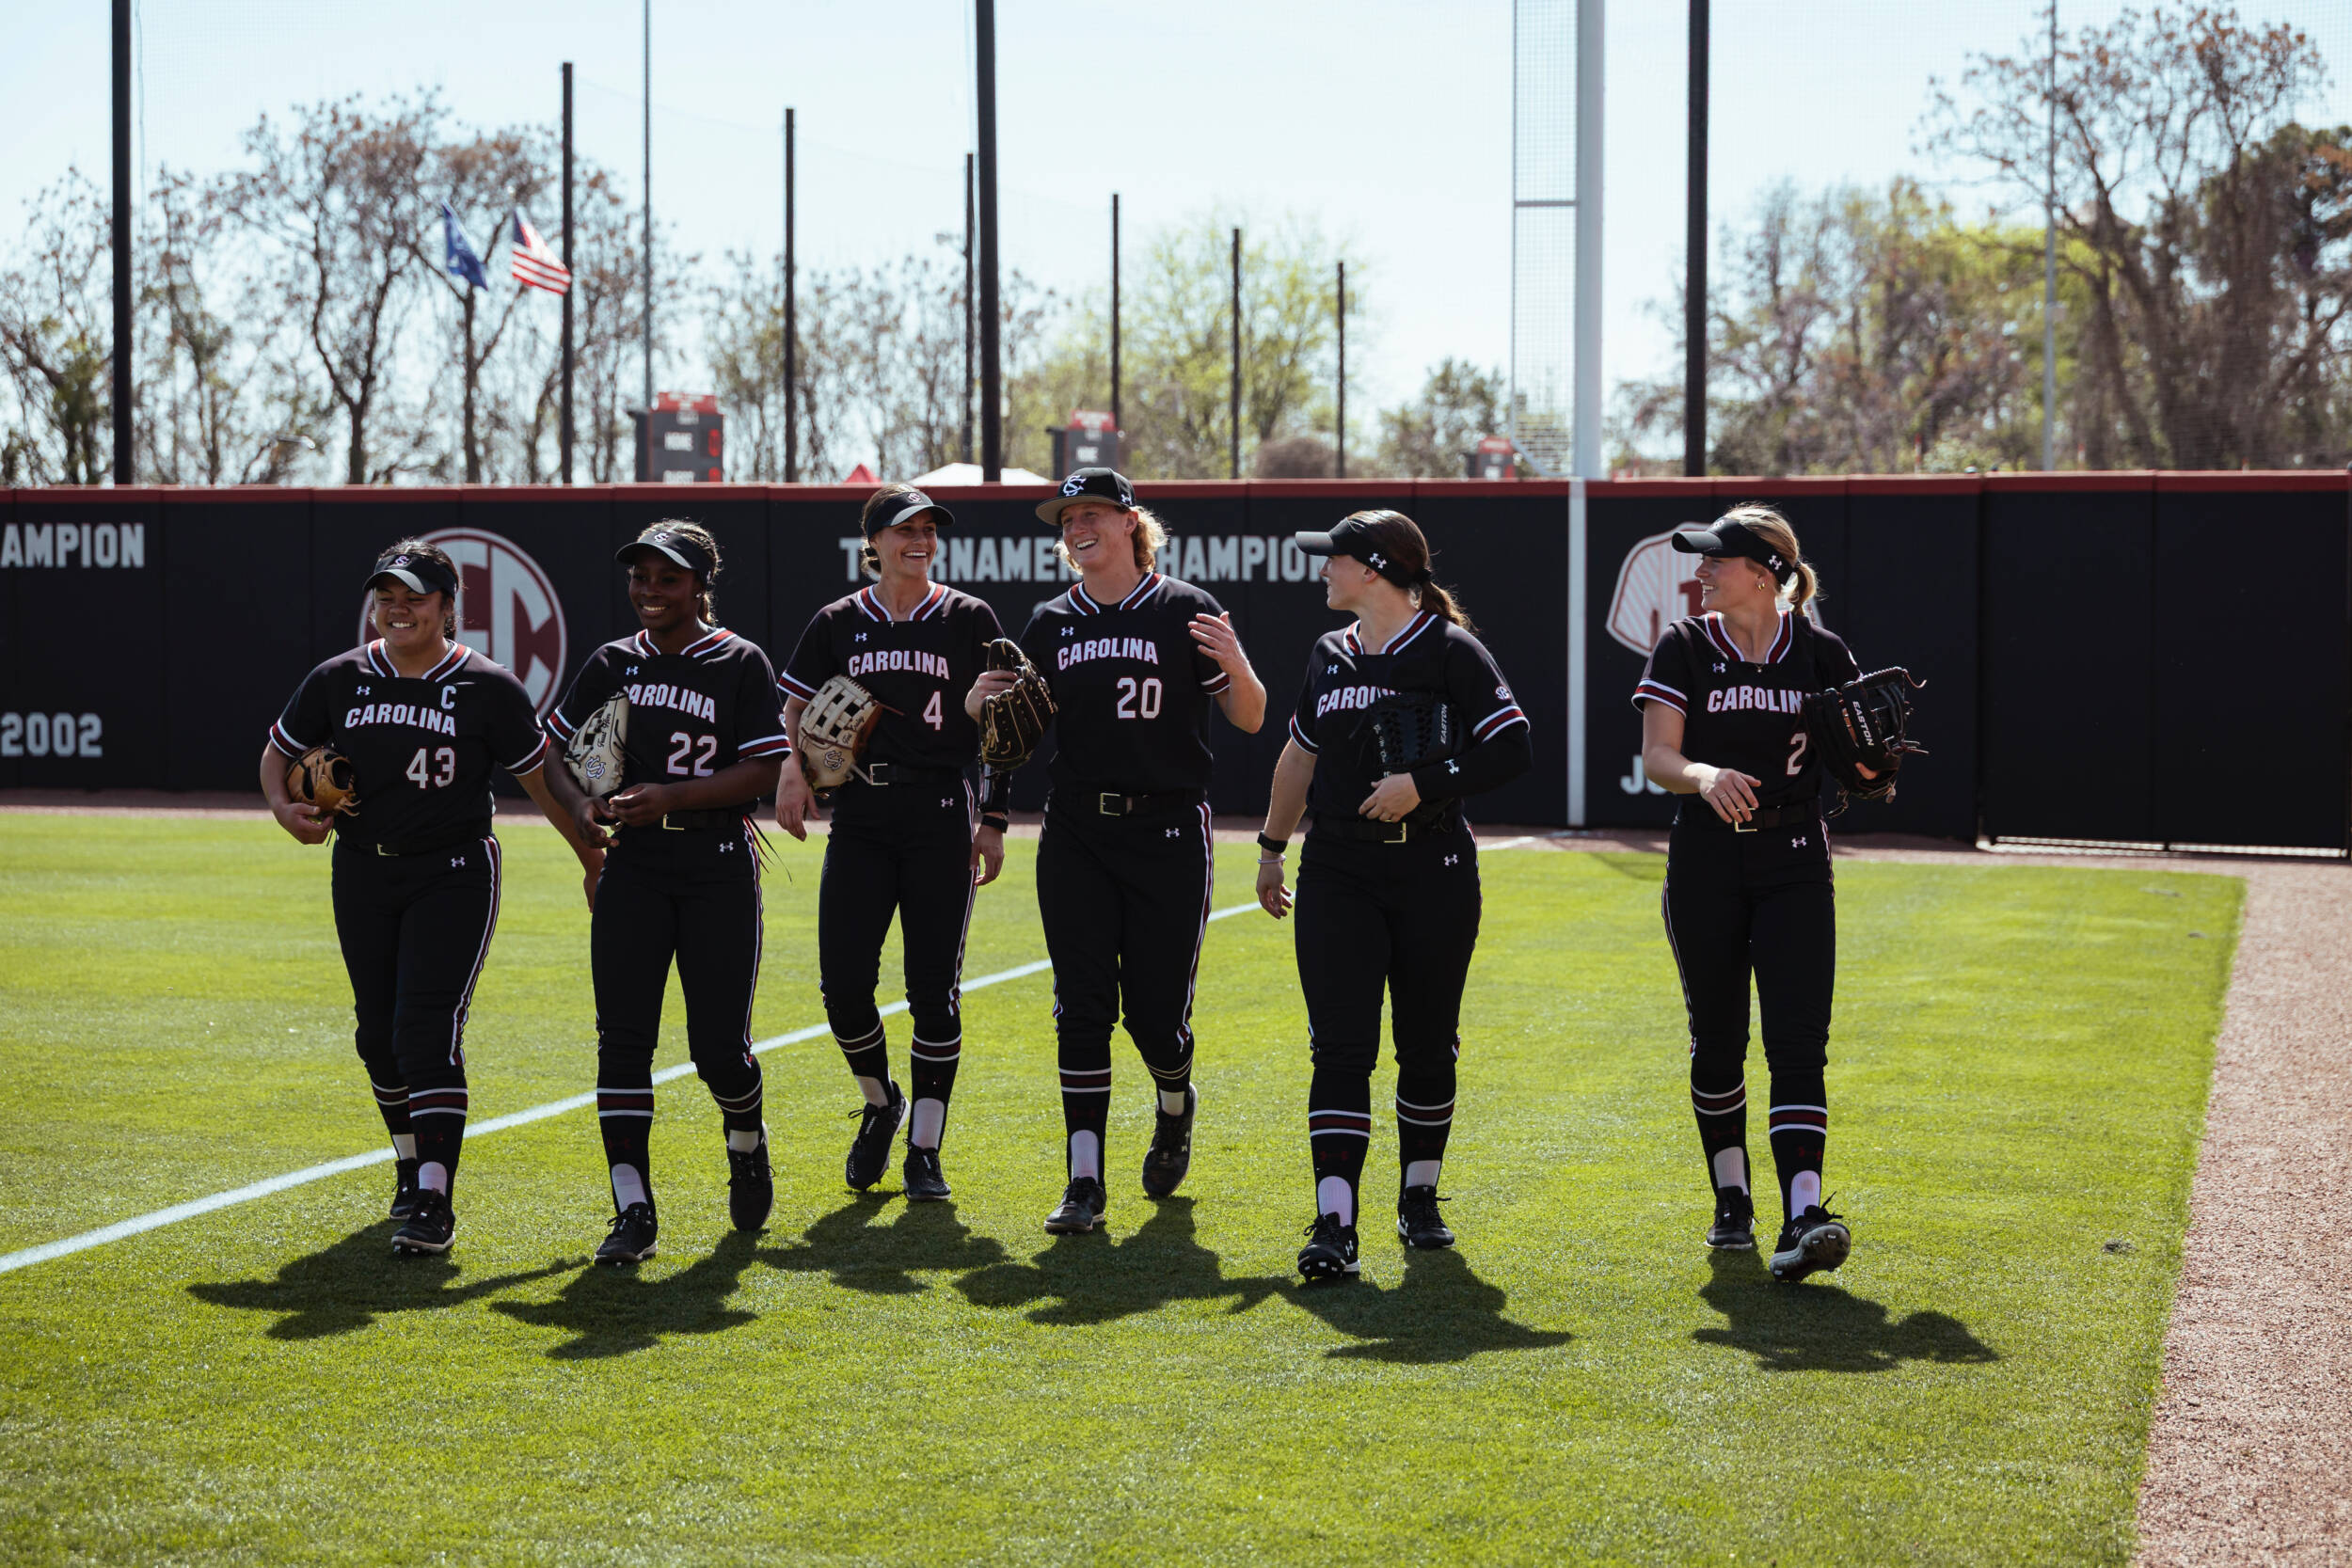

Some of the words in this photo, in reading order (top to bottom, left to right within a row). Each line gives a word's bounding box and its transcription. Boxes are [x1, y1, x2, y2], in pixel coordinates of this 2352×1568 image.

[0, 522, 145, 569] AMPION
[848, 649, 951, 681] CAROLINA
[1057, 637, 1159, 672] CAROLINA
[440, 685, 457, 710] C
[623, 683, 716, 724] AROLINA
[922, 689, 944, 731] 4
[1116, 676, 1163, 720] 20
[1706, 684, 1812, 715] CAROLIN
[0, 711, 103, 758] 2002
[343, 703, 457, 737] CAROLINA
[1851, 701, 1875, 746] EASTON
[405, 746, 456, 790] 43
[666, 730, 719, 778] 22
